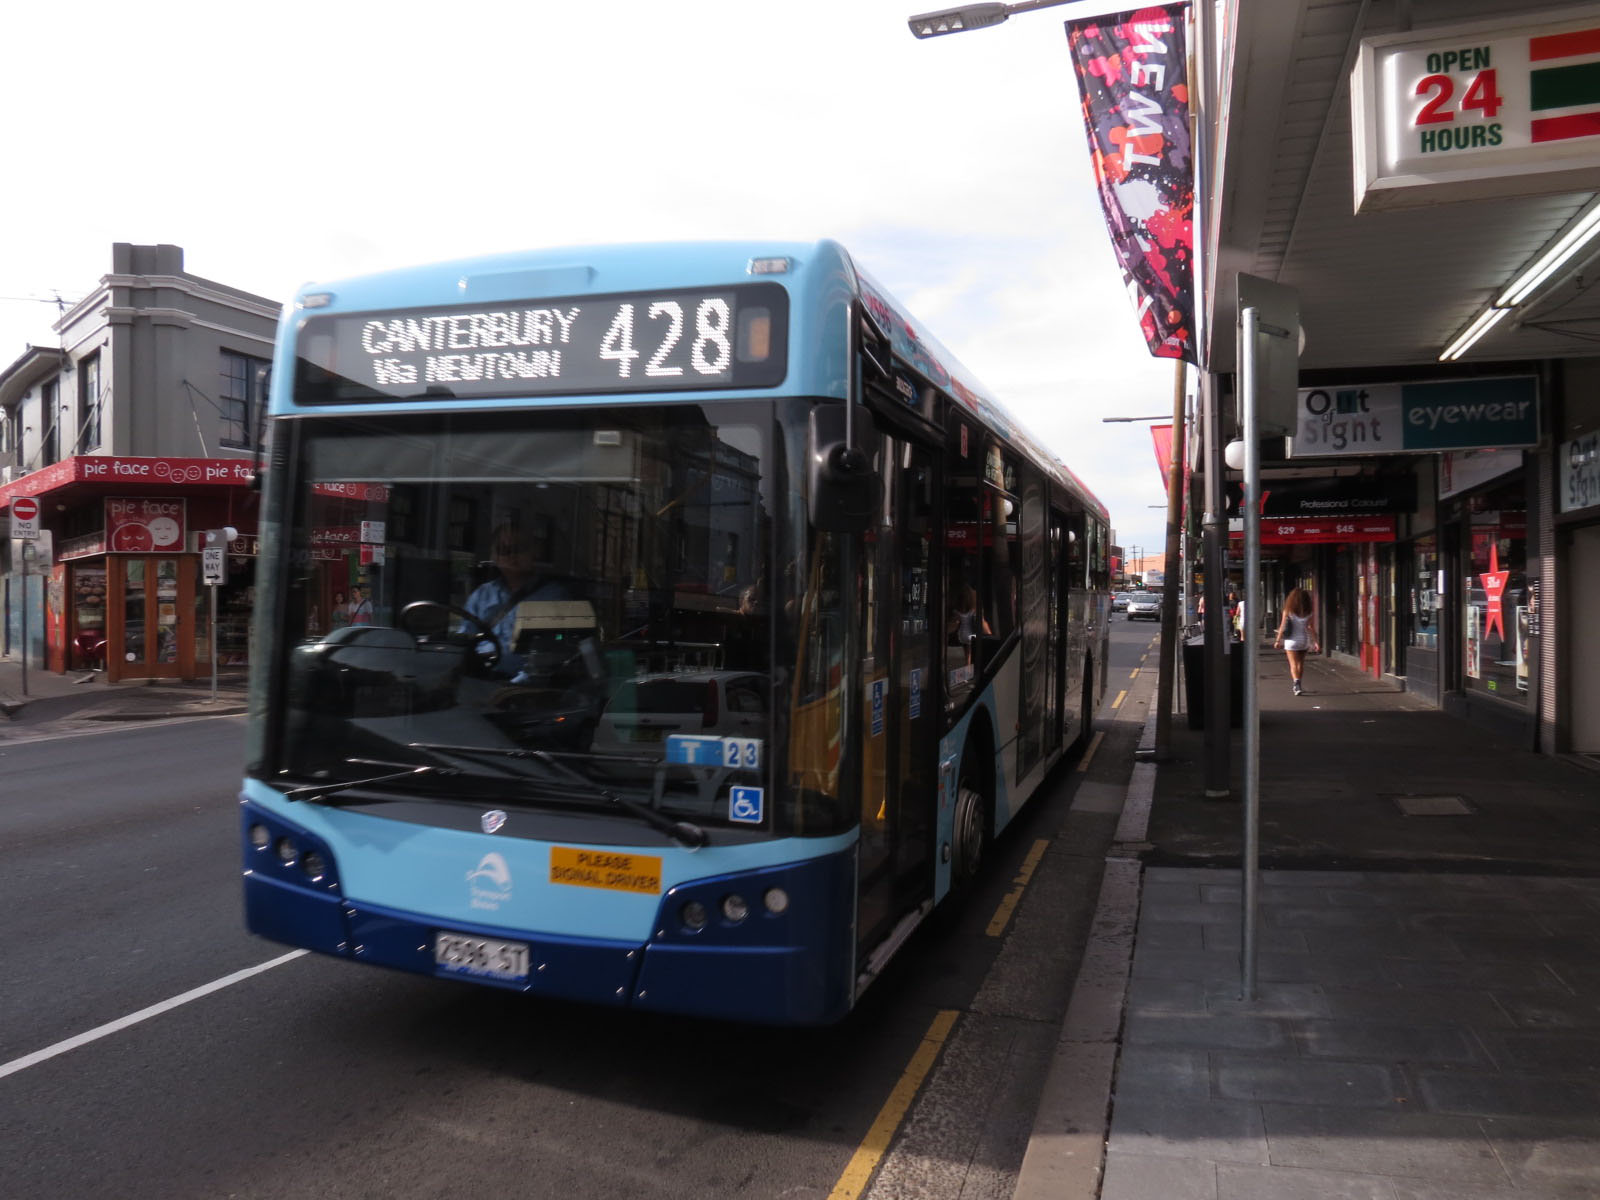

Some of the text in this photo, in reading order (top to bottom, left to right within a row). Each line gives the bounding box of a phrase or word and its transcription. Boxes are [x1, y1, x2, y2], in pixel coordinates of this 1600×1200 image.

[1426, 46, 1490, 74] OPEN
[1415, 69, 1503, 125] 24
[1420, 123, 1503, 153] HOURS
[361, 298, 731, 378] CANTERBURY 428
[425, 350, 562, 382] NEWTOWN
[1408, 400, 1531, 430] eyewear
[84, 460, 149, 477] pie face
[206, 463, 256, 480] pie fac
[111, 500, 179, 516] pie face
[1277, 526, 1296, 535] $29
[1335, 524, 1355, 534] $45
[205, 551, 220, 560] ONE
[205, 563, 220, 572] WAY
[680, 741, 756, 765] T 23
[577, 853, 633, 871] PLEASE
[552, 866, 658, 890] SIGNAL DRIVER
